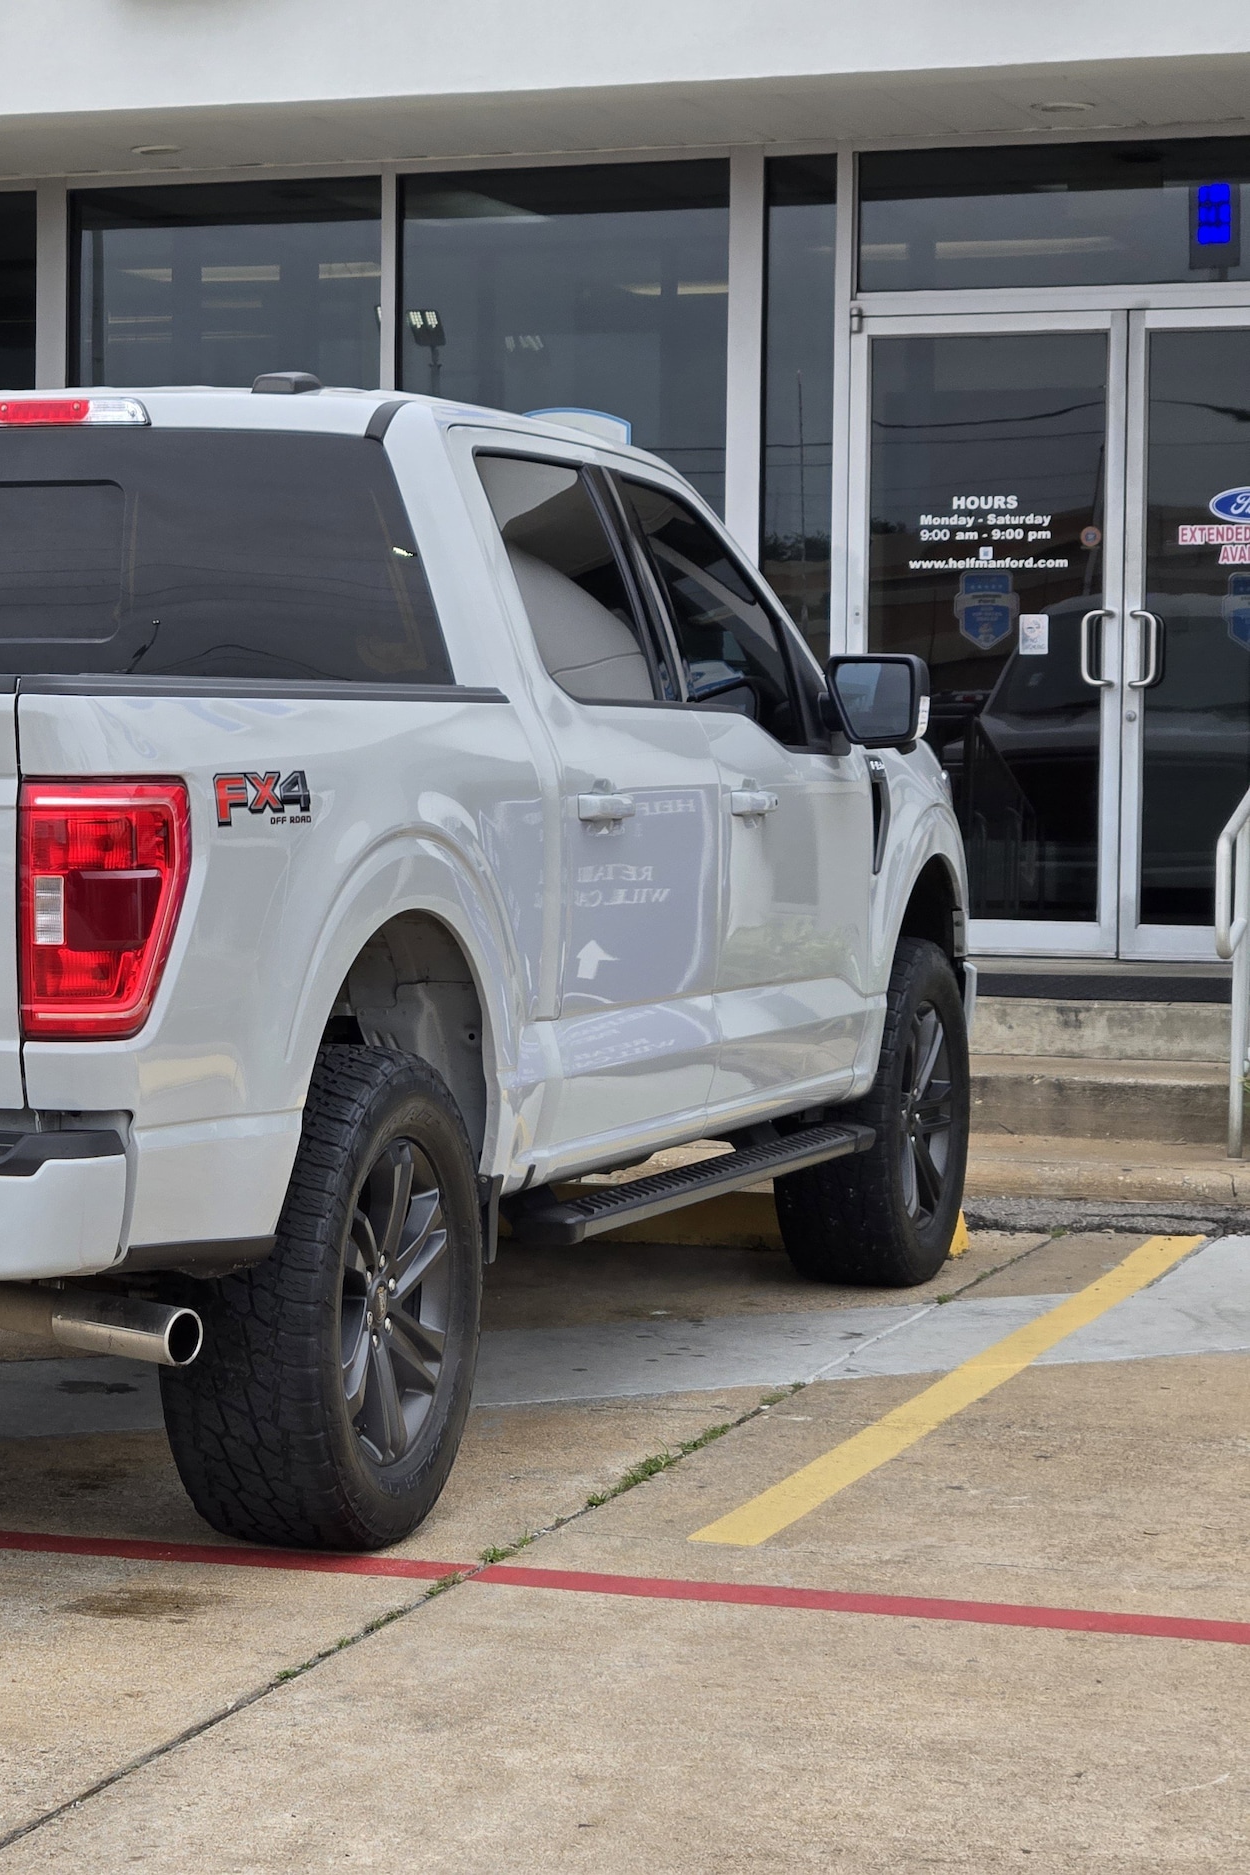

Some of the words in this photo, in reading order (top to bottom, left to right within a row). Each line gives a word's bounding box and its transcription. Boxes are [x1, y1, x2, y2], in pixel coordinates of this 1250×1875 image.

[952, 495, 1019, 510] HOURS
[919, 514, 975, 527] Monday
[986, 513, 1052, 527] Saturday
[919, 529, 950, 541] 9:00
[955, 531, 978, 541] am
[991, 528, 1024, 541] 9:00
[1027, 530, 1051, 542] pm
[1180, 526, 1250, 544] EXTENDED
[908, 557, 1069, 569] www.helfmanford.com
[213, 770, 310, 827] FX4
[270, 817, 287, 825] OFF
[290, 816, 312, 824] ROAD
